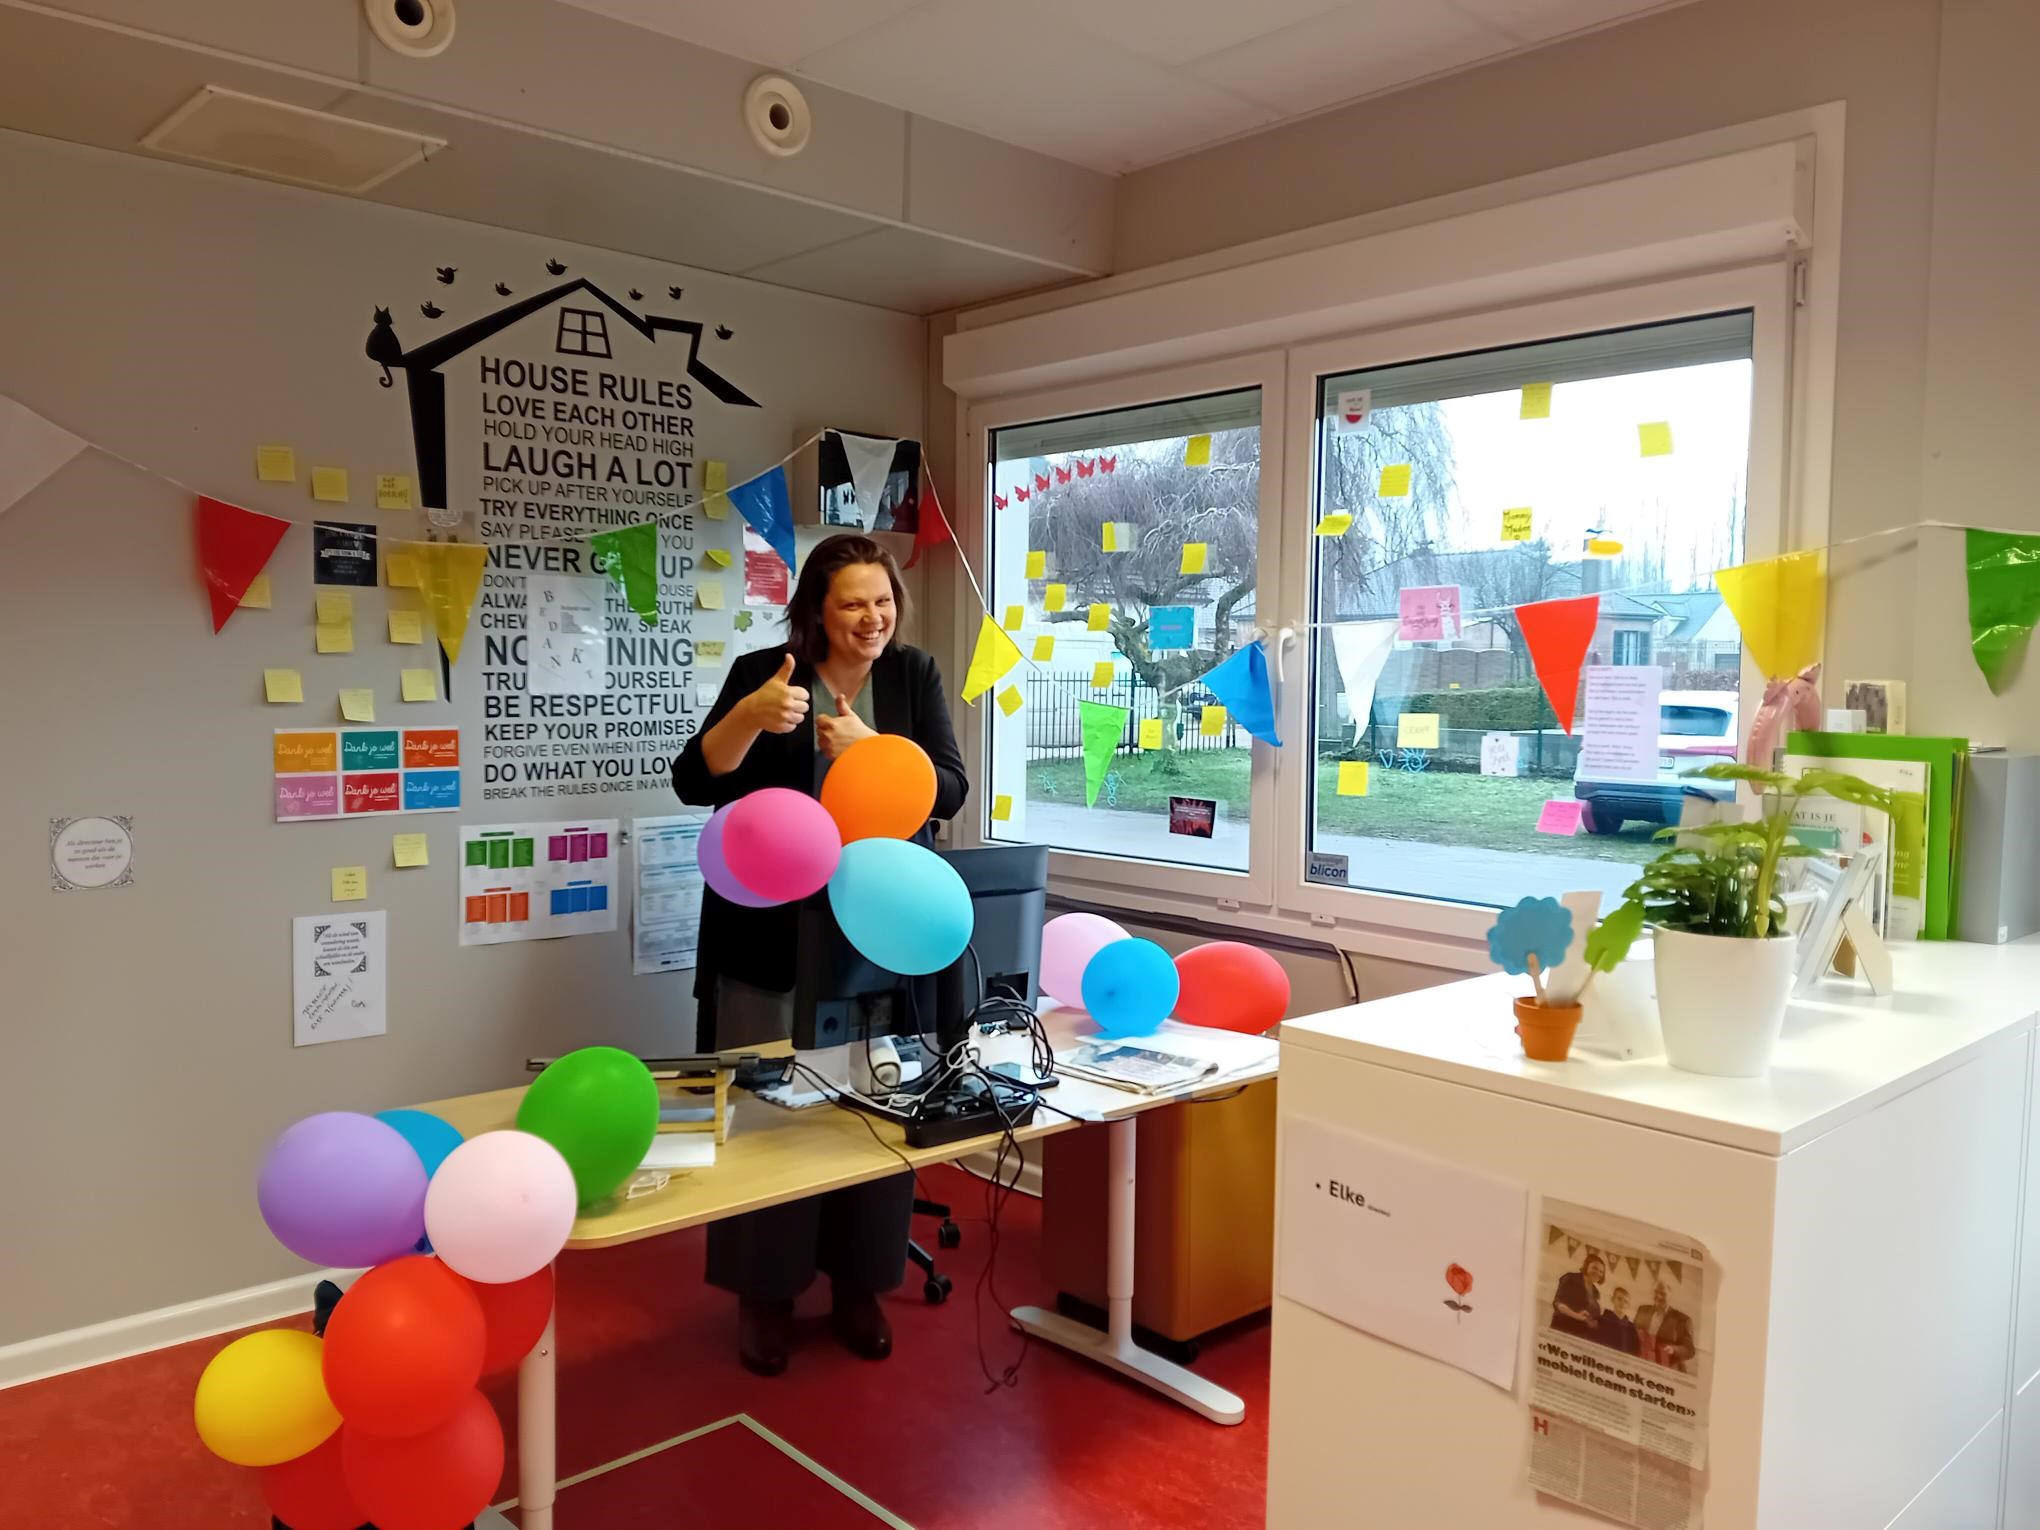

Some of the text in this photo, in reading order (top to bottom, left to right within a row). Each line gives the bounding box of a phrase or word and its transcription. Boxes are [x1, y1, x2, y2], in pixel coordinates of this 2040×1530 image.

[480, 355, 692, 410] HOUSE RULES
[482, 392, 694, 437] LOVE EACH OTHER
[484, 418, 693, 458] HOLD YOUR HEAD HIGH
[483, 441, 693, 489] LAUGH A LOT
[483, 476, 693, 508] PICK UP AFTER YOURSELF
[480, 498, 693, 531] TRY EVERYTHING ONCE
[481, 521, 584, 543] SAY PLEASE
[661, 534, 693, 551] YOU
[483, 542, 580, 574] NEVER
[660, 555, 693, 580] UP
[483, 574, 527, 589] DON'T
[656, 583, 693, 597] OUSE
[481, 592, 527, 609] ALWA
[656, 600, 693, 615] RUTH
[606, 636, 694, 667] INING
[482, 670, 693, 691] TRU OURSELF
[484, 693, 693, 719] BE RESPECTFUL
[485, 718, 696, 741] KEEP YOUR PROMISES
[483, 738, 687, 759] FORGIVE EVEN WHEN ITS HAR
[484, 756, 673, 783] DO WHAT YOU LO
[483, 786, 527, 800] BREAK
[529, 785, 554, 797] THE
[557, 782, 597, 795] RULES
[600, 780, 633, 793] ONCE
[636, 779, 648, 790] IN
[650, 779, 658, 789] A
[1310, 862, 1346, 878] blicon
[1329, 1179, 1365, 1207] Elke
[1537, 1355, 1588, 1381] mobiel
[1588, 1371, 1627, 1395] team
[1570, 1350, 1615, 1375] willen
[1615, 1368, 1646, 1386] ook
[1646, 1379, 1675, 1397] een
[1533, 1416, 1549, 1436] H
